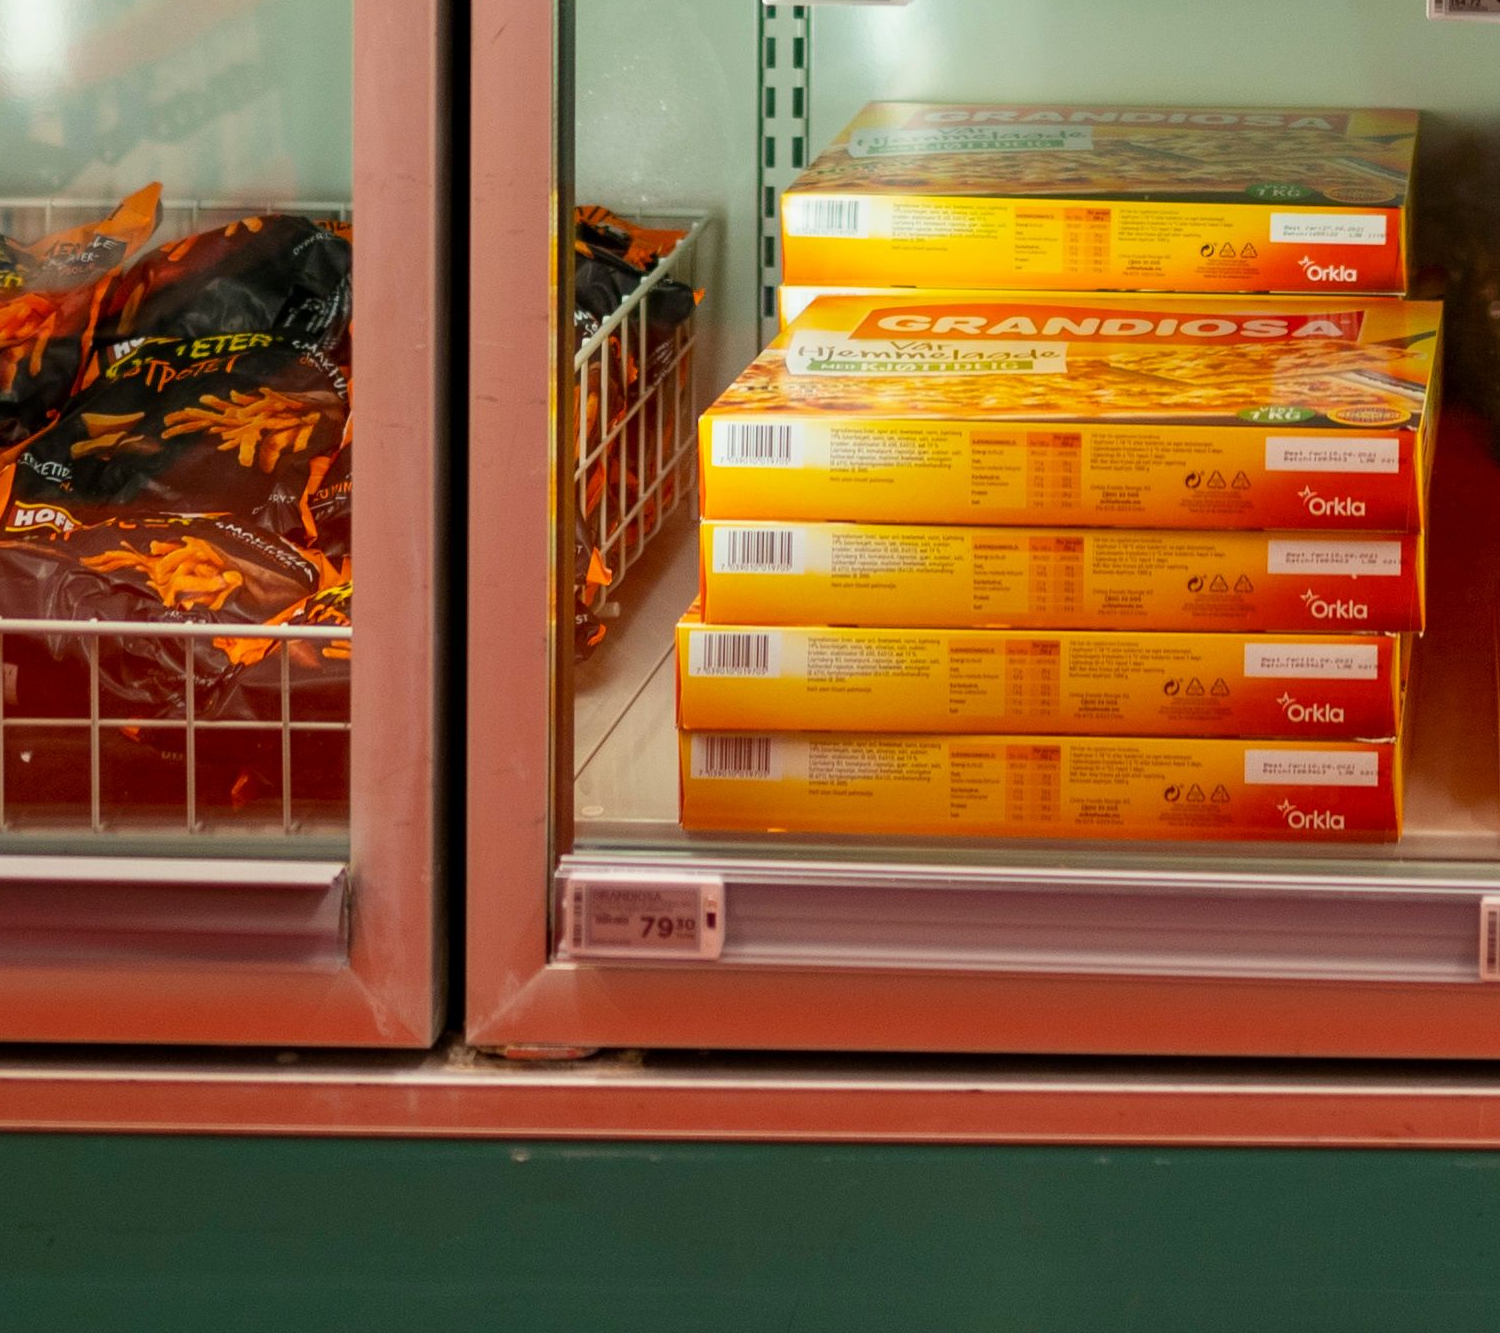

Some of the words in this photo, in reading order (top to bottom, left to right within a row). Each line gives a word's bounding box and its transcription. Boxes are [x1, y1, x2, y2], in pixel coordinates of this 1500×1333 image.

[877, 313, 1343, 340] GRANDIOSA
[797, 344, 1061, 363] Hjemmelagde
[861, 361, 1021, 371] KJØTTDEIG
[1308, 496, 1366, 519] Orkla
